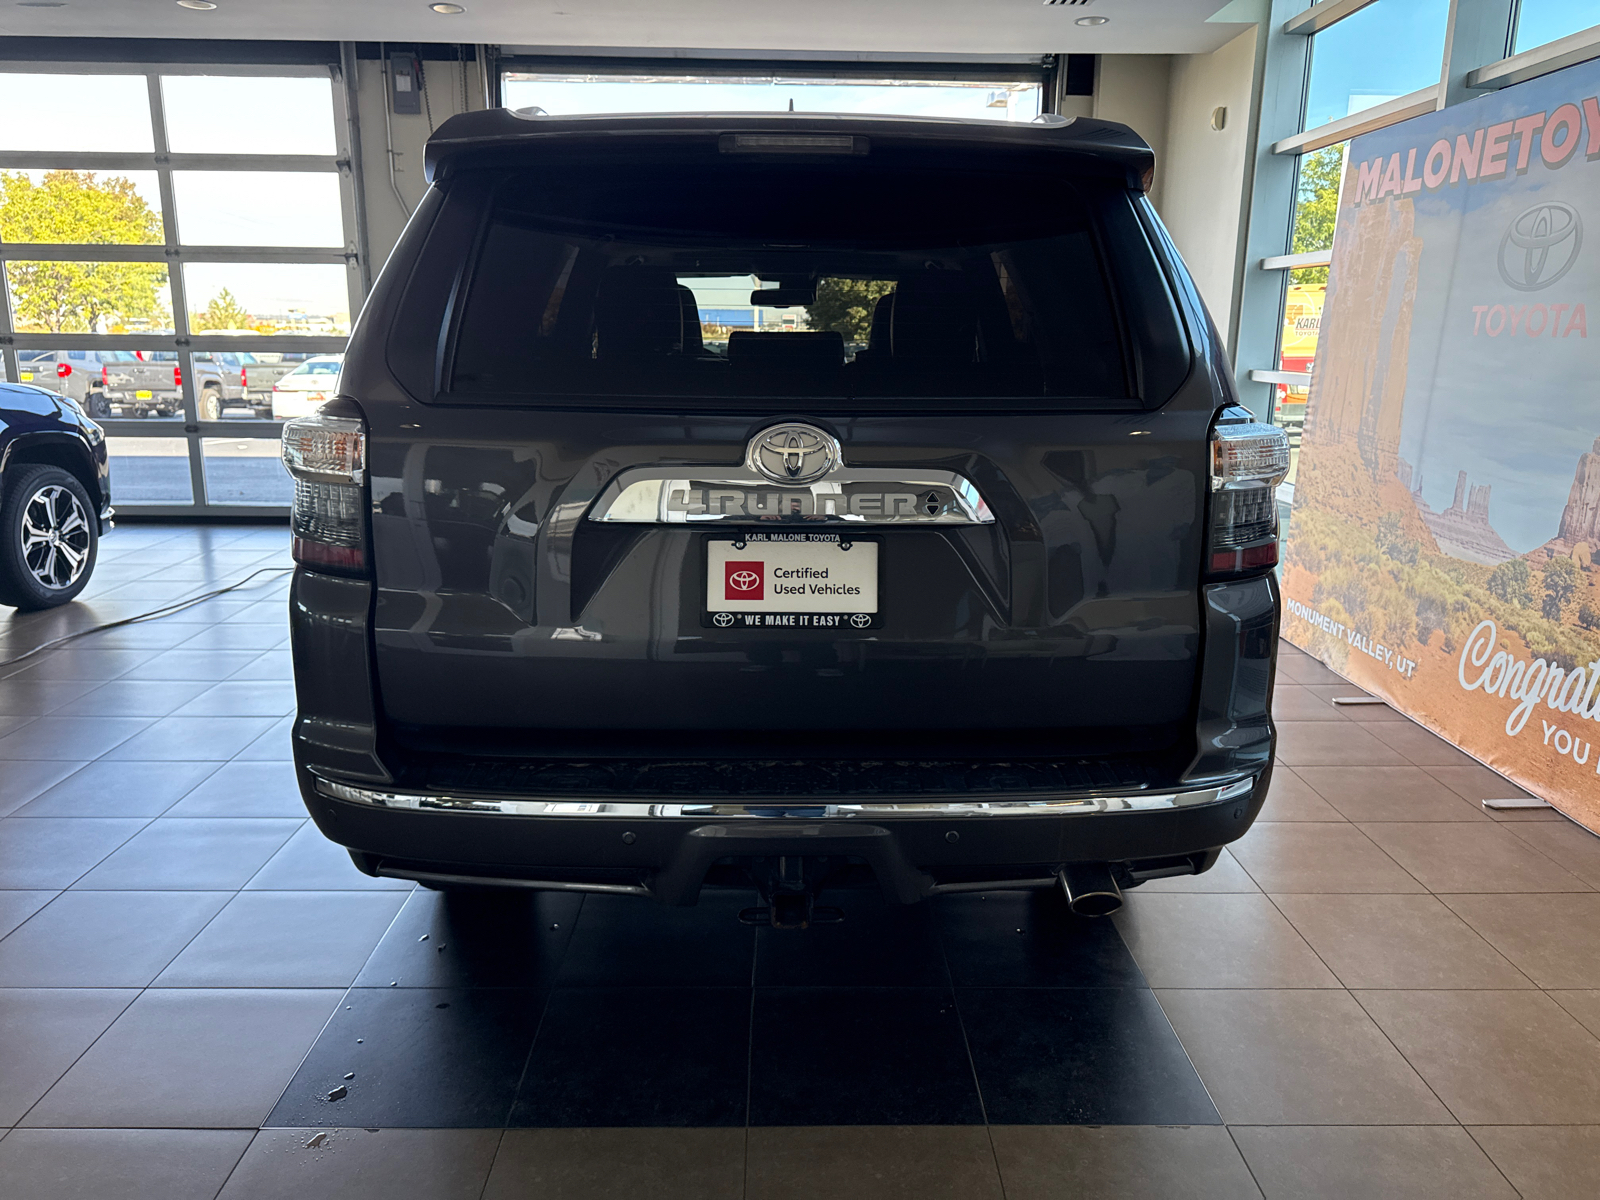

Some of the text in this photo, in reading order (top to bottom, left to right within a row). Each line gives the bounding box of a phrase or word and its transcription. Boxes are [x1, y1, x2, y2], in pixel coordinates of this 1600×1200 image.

[1295, 317, 1321, 329] KARL
[1472, 303, 1587, 339] TOYOTA
[745, 533, 841, 542] KARL MALONE TOYOTA
[773, 567, 829, 579] Certified
[773, 583, 861, 595] Used Vehicles
[744, 614, 840, 626] WE MAKE IT EASY
[1286, 598, 1416, 678] MONUMENT VALLEY, UT
[1458, 619, 1600, 736] Congrat
[1542, 719, 1591, 765] YOU
